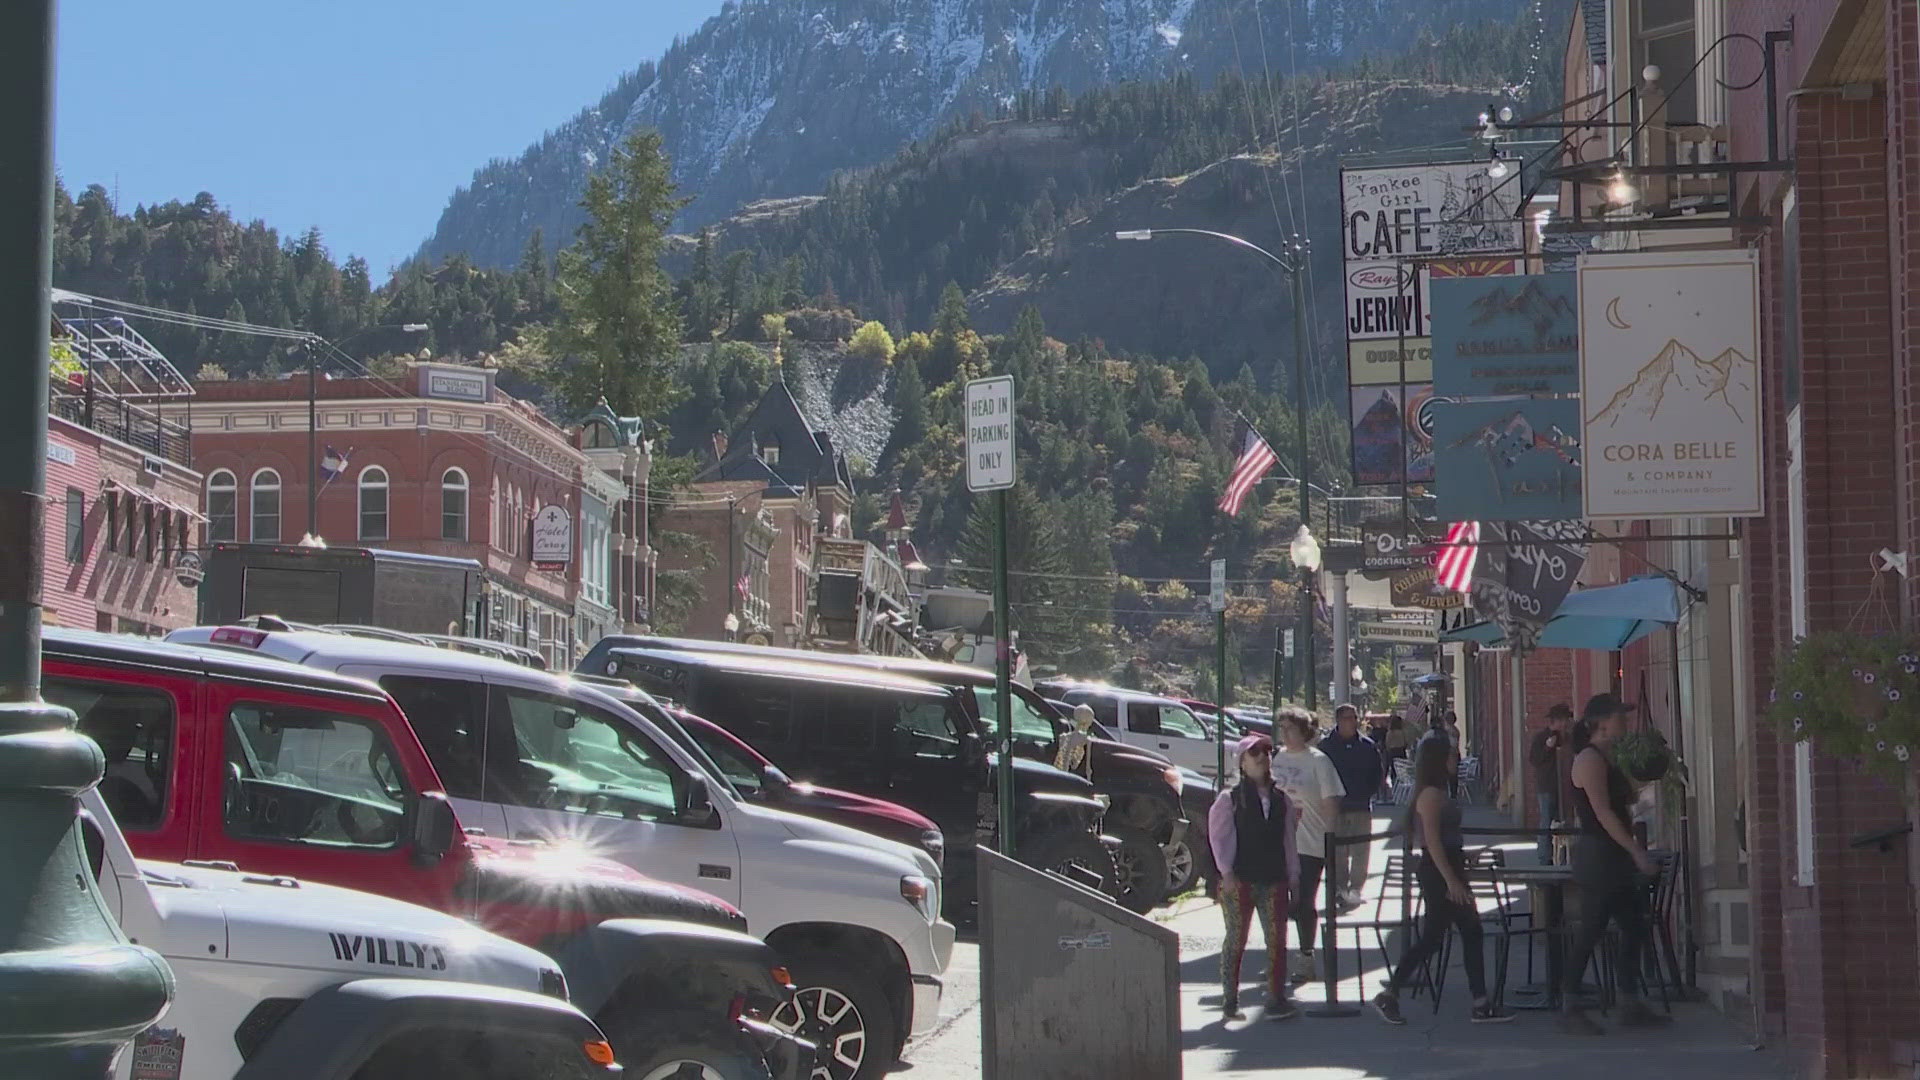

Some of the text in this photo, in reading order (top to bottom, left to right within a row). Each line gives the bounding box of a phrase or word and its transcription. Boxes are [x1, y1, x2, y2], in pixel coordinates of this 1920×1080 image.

[1356, 176, 1421, 198] Yankee
[1380, 190, 1422, 208] Girl
[1350, 207, 1433, 256] CAFE
[1350, 295, 1413, 334] JERKY
[971, 396, 1008, 417] HEAD IN
[971, 423, 1009, 444] PARKING
[979, 450, 1003, 470] ONLY
[1603, 441, 1737, 462] CORA BELLE
[1644, 470, 1713, 481] COMPANY
[536, 524, 569, 537] Hotel
[1365, 556, 1412, 567] COCKTAILS
[1421, 592, 1464, 608] JEWEL
[327, 930, 447, 972] WILLYS
